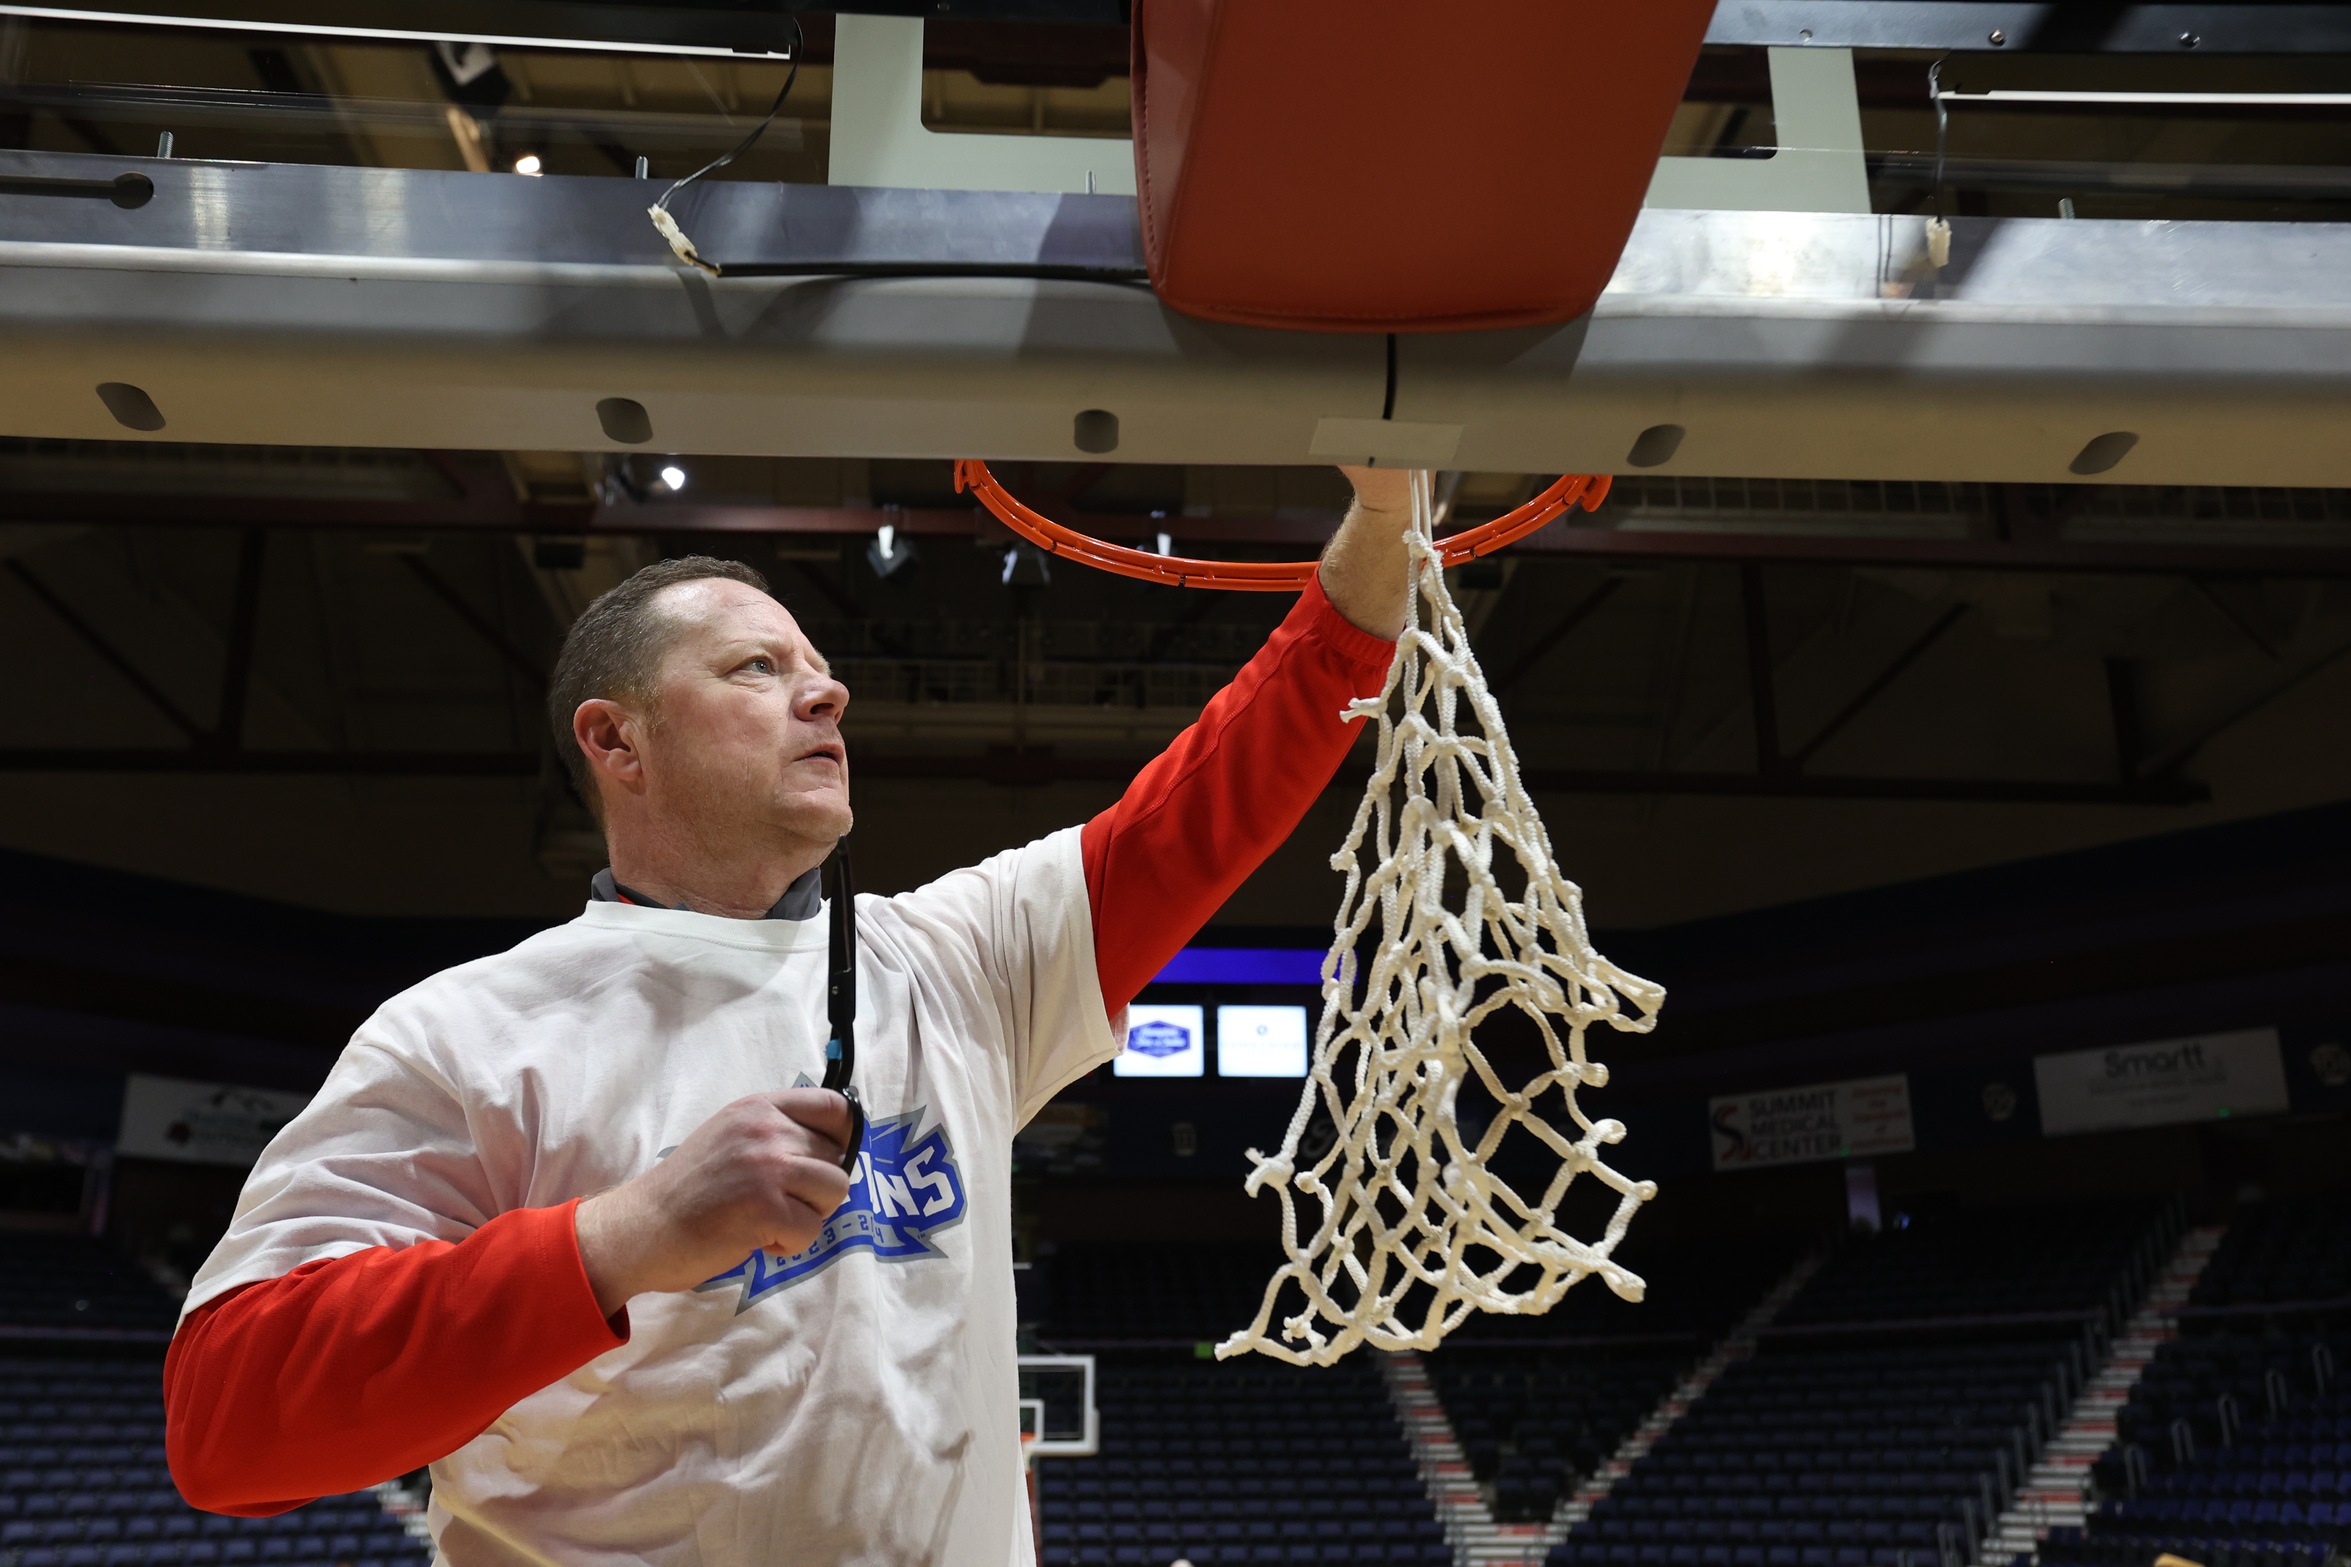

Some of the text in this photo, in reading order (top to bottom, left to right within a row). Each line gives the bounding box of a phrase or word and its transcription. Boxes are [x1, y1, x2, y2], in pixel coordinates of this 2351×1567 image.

[1749, 1090, 1837, 1118] SUMMIT
[1751, 1115, 1840, 1138] MEDICAL
[1754, 1134, 1842, 1162] CENTER
